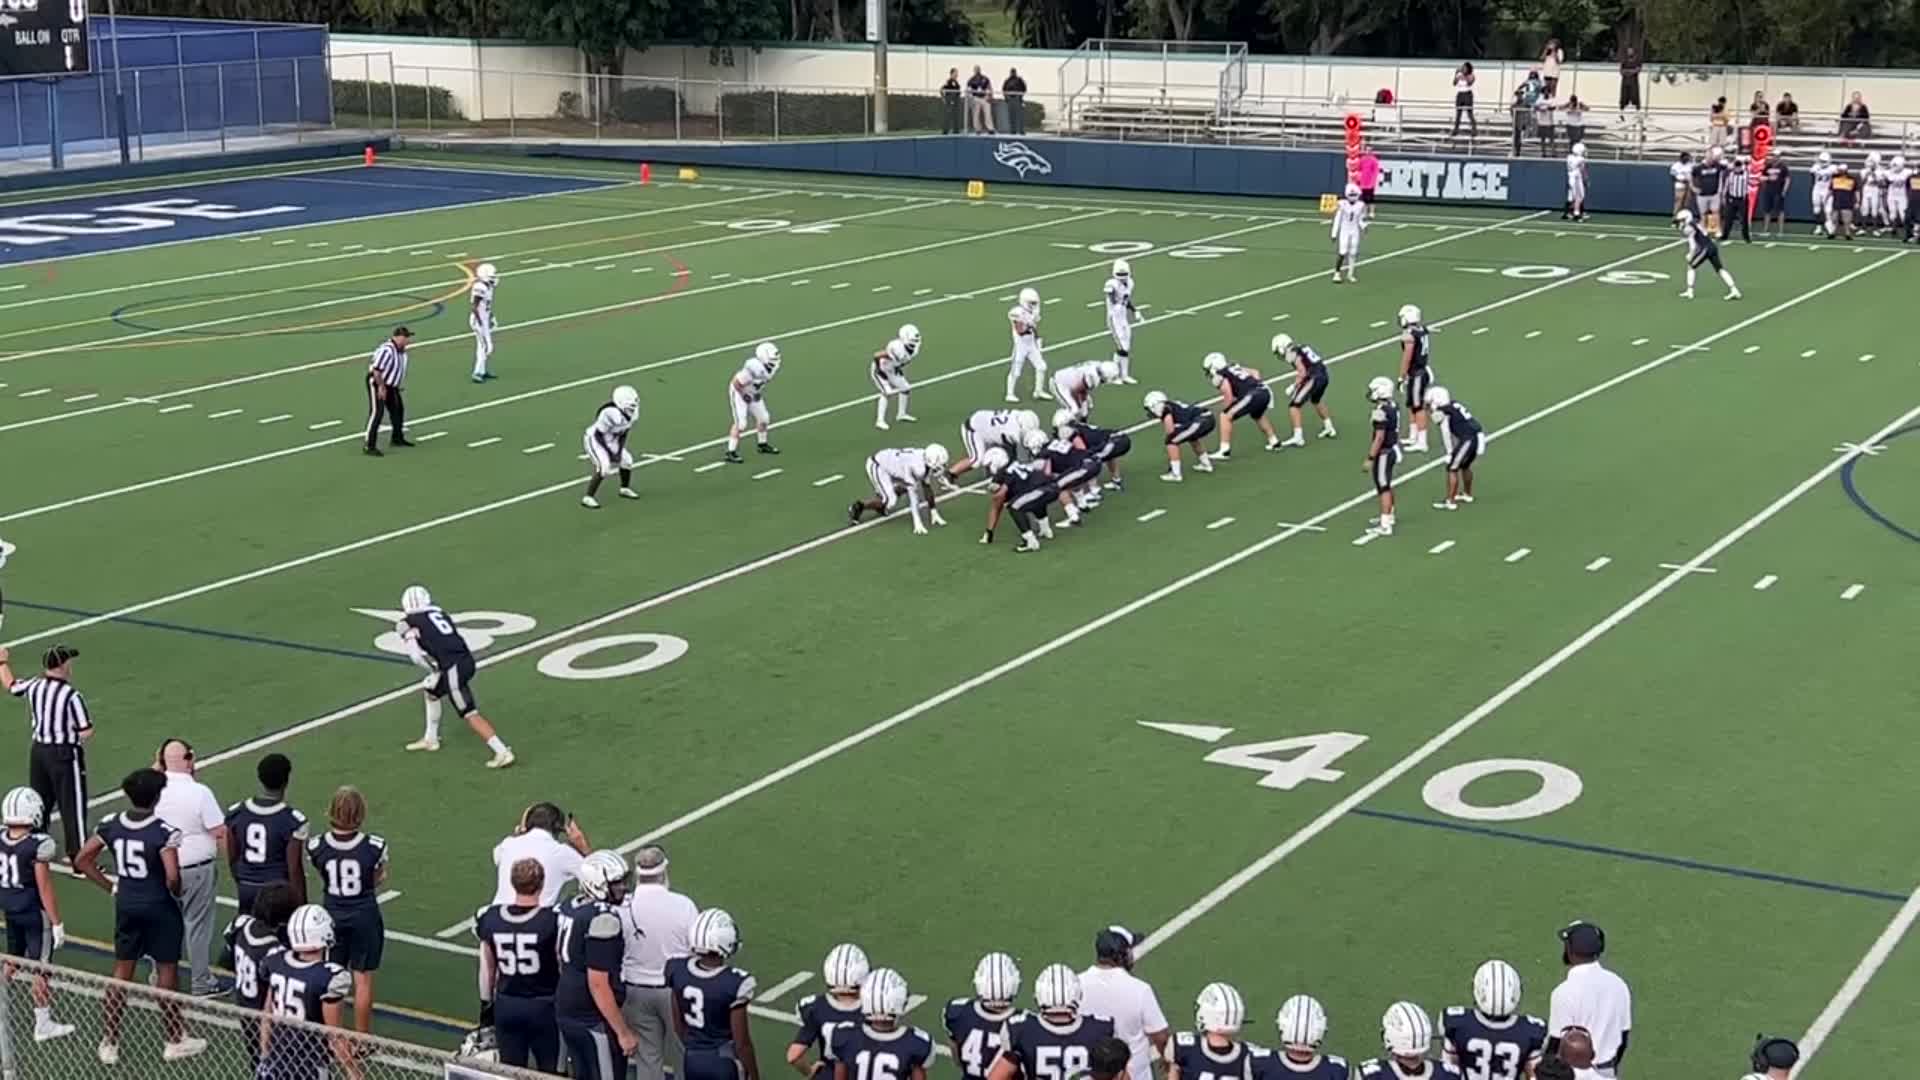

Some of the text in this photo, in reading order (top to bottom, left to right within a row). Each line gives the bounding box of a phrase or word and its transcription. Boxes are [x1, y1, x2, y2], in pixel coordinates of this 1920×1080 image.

[15, 29, 50, 45] BALL ON
[61, 28, 80, 43] QTR
[428, 611, 454, 635] 6
[113, 837, 149, 878] 15
[245, 822, 268, 864] 9
[325, 858, 362, 898] 18
[492, 933, 541, 977] 55
[269, 972, 307, 1022] 35
[682, 985, 705, 1029] 3
[855, 1050, 899, 1080] 16
[1465, 1037, 1522, 1080] 33
